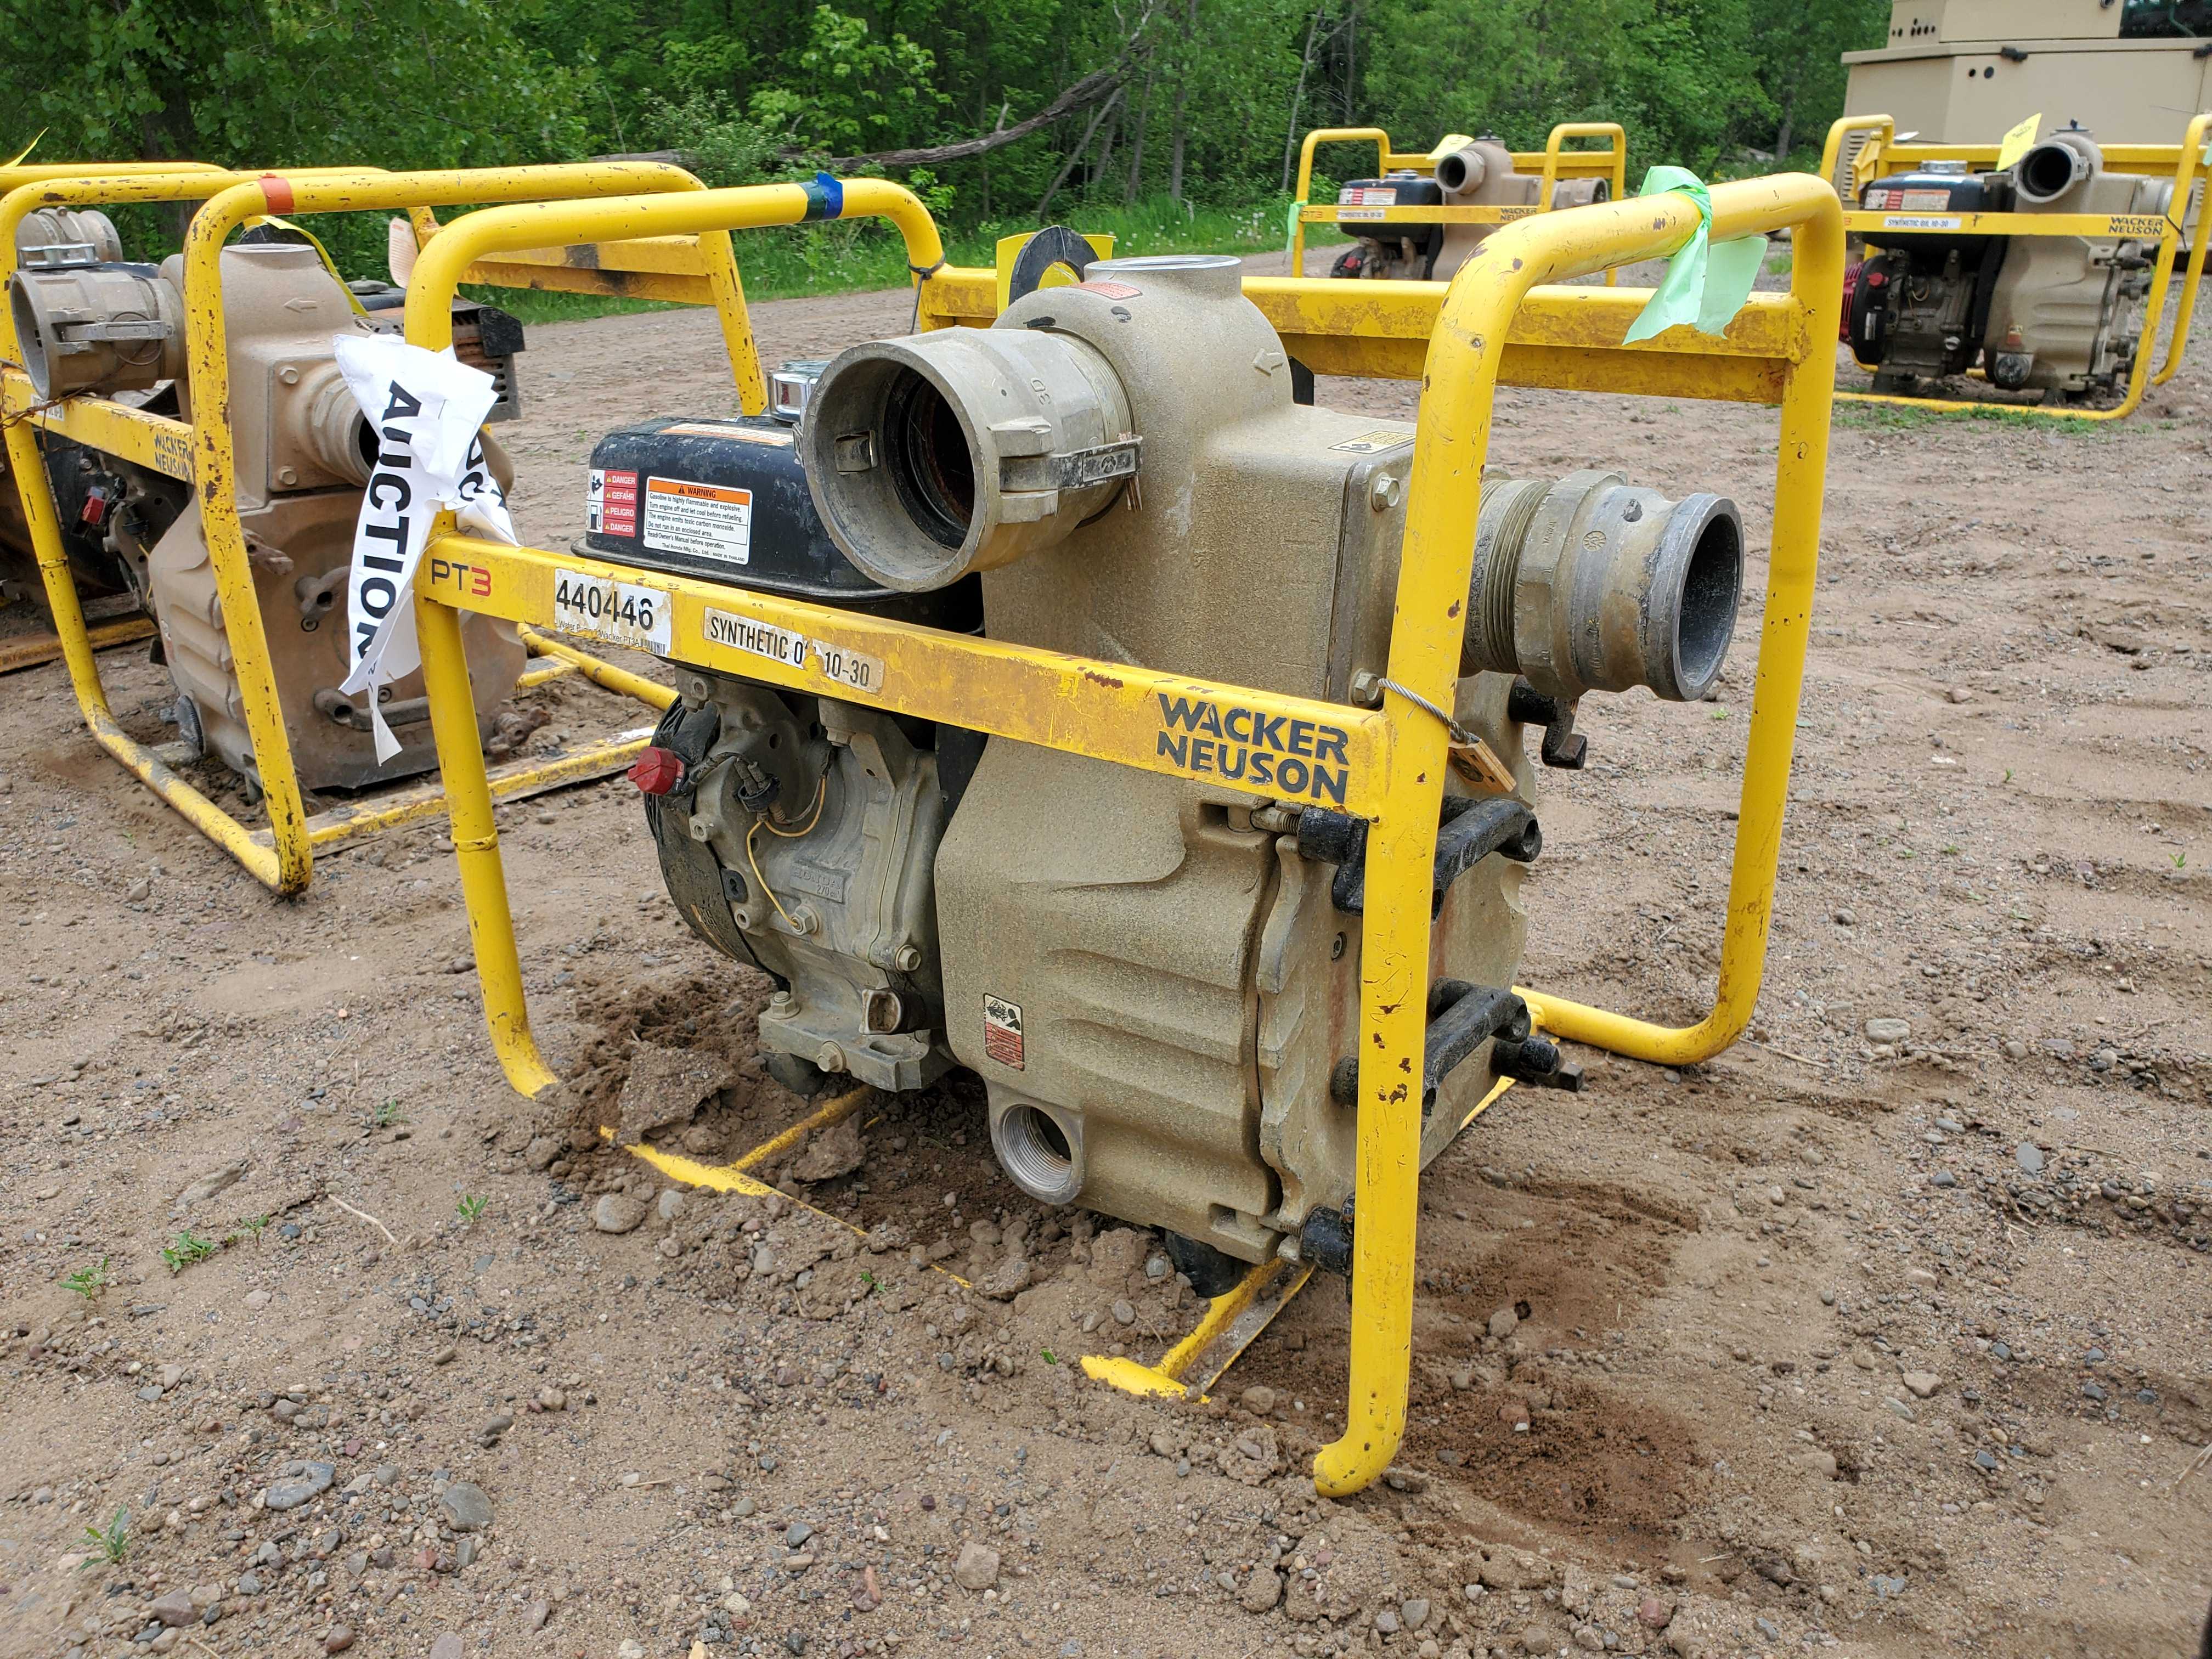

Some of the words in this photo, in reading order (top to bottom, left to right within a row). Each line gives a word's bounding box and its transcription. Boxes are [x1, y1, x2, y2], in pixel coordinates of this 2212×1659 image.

[2111, 217, 2164, 227] WACKER
[2109, 225, 2163, 235] NEUSON
[154, 432, 190, 459] WACKER
[612, 475, 635, 485] DANGER
[612, 491, 634, 501] GEFAHR
[687, 486, 716, 499] WARNING
[650, 493, 667, 501] Gasoline
[673, 496, 685, 505] highly
[686, 498, 709, 507] flammable
[720, 504, 742, 512] explosive.
[610, 507, 634, 517] PELIGRO
[707, 510, 721, 518] before
[610, 523, 634, 533] DANGER
[712, 523, 736, 532] monoxide.
[658, 532, 674, 541] Owner's
[675, 535, 690, 544] Manual
[690, 537, 704, 546] before
[431, 558, 492, 597] PT3
[556, 579, 654, 631] 440446
[623, 635, 640, 647] PT3A
[710, 616, 788, 660] SYNTHETIC
[825, 651, 871, 687] 10-30
[1157, 692, 1351, 766] WACKER
[1156, 730, 1348, 805] NEUSON
